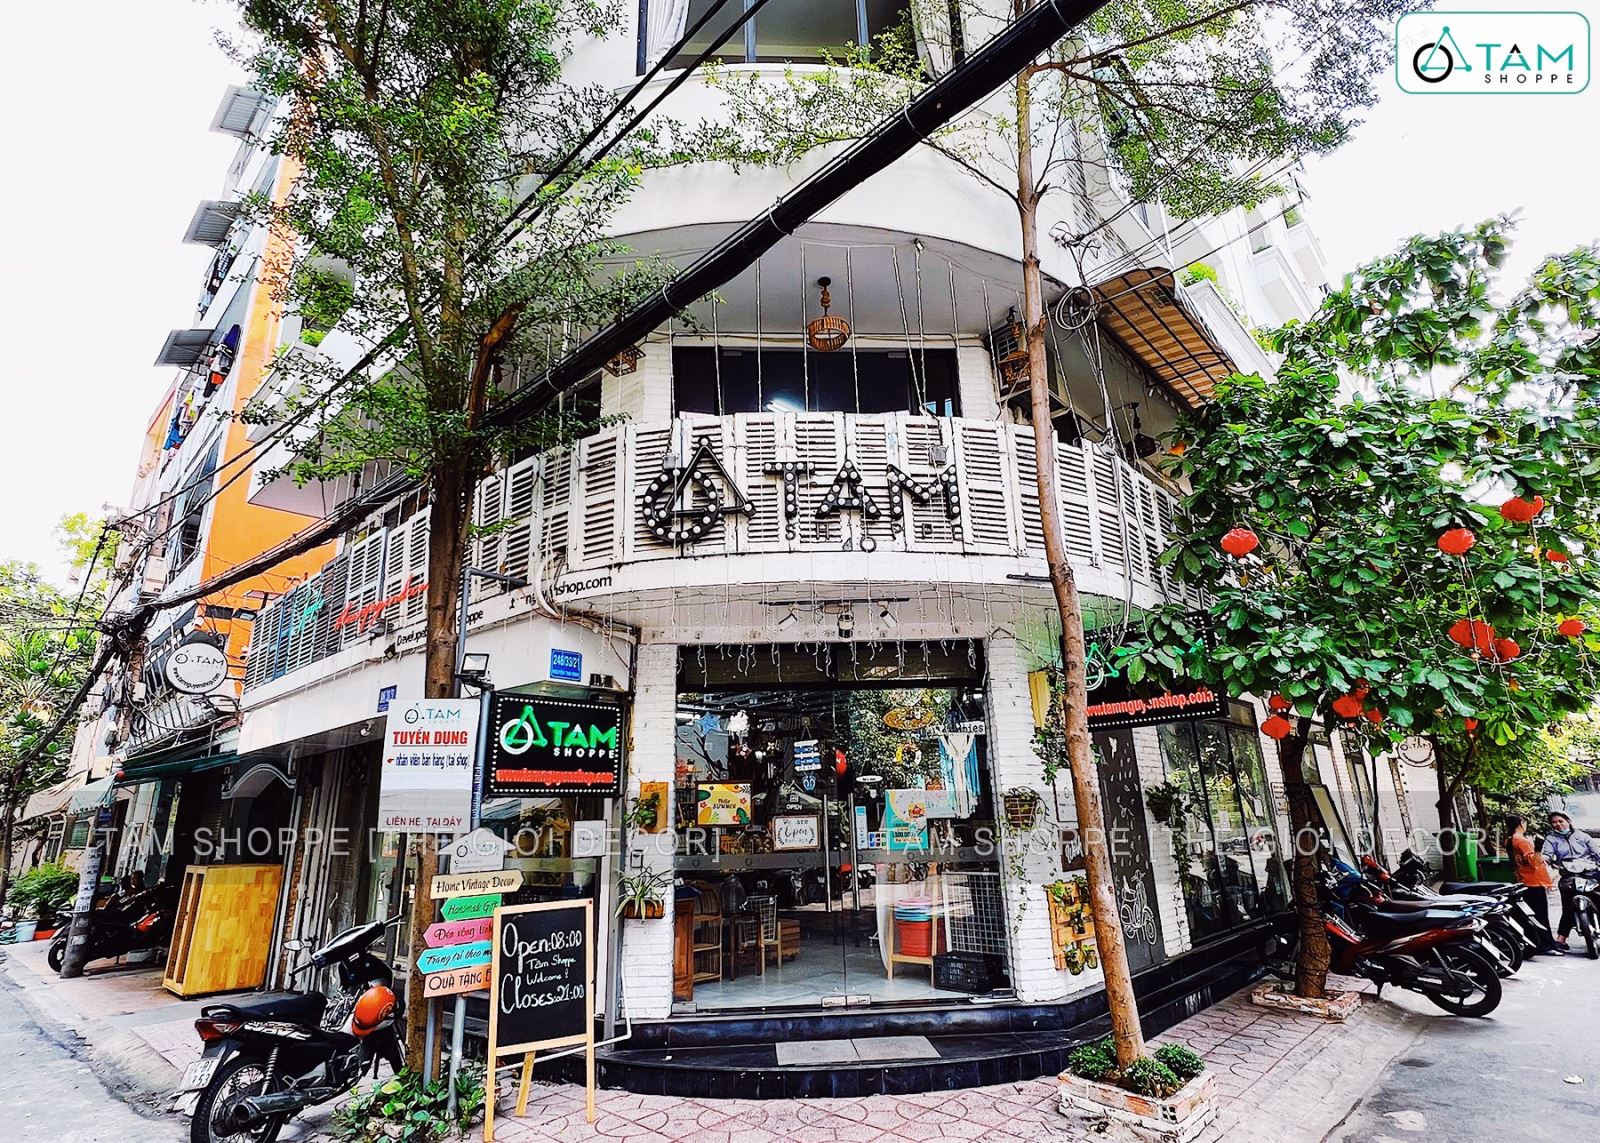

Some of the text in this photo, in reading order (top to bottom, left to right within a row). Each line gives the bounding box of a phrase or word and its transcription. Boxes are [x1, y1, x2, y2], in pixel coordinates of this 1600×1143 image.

[763, 458, 960, 520] TAM
[547, 721, 617, 749] TAM
[553, 747, 614, 758] SHOPPE
[436, 876, 514, 893] Home Vintage Decor
[426, 955, 450, 966] Trang
